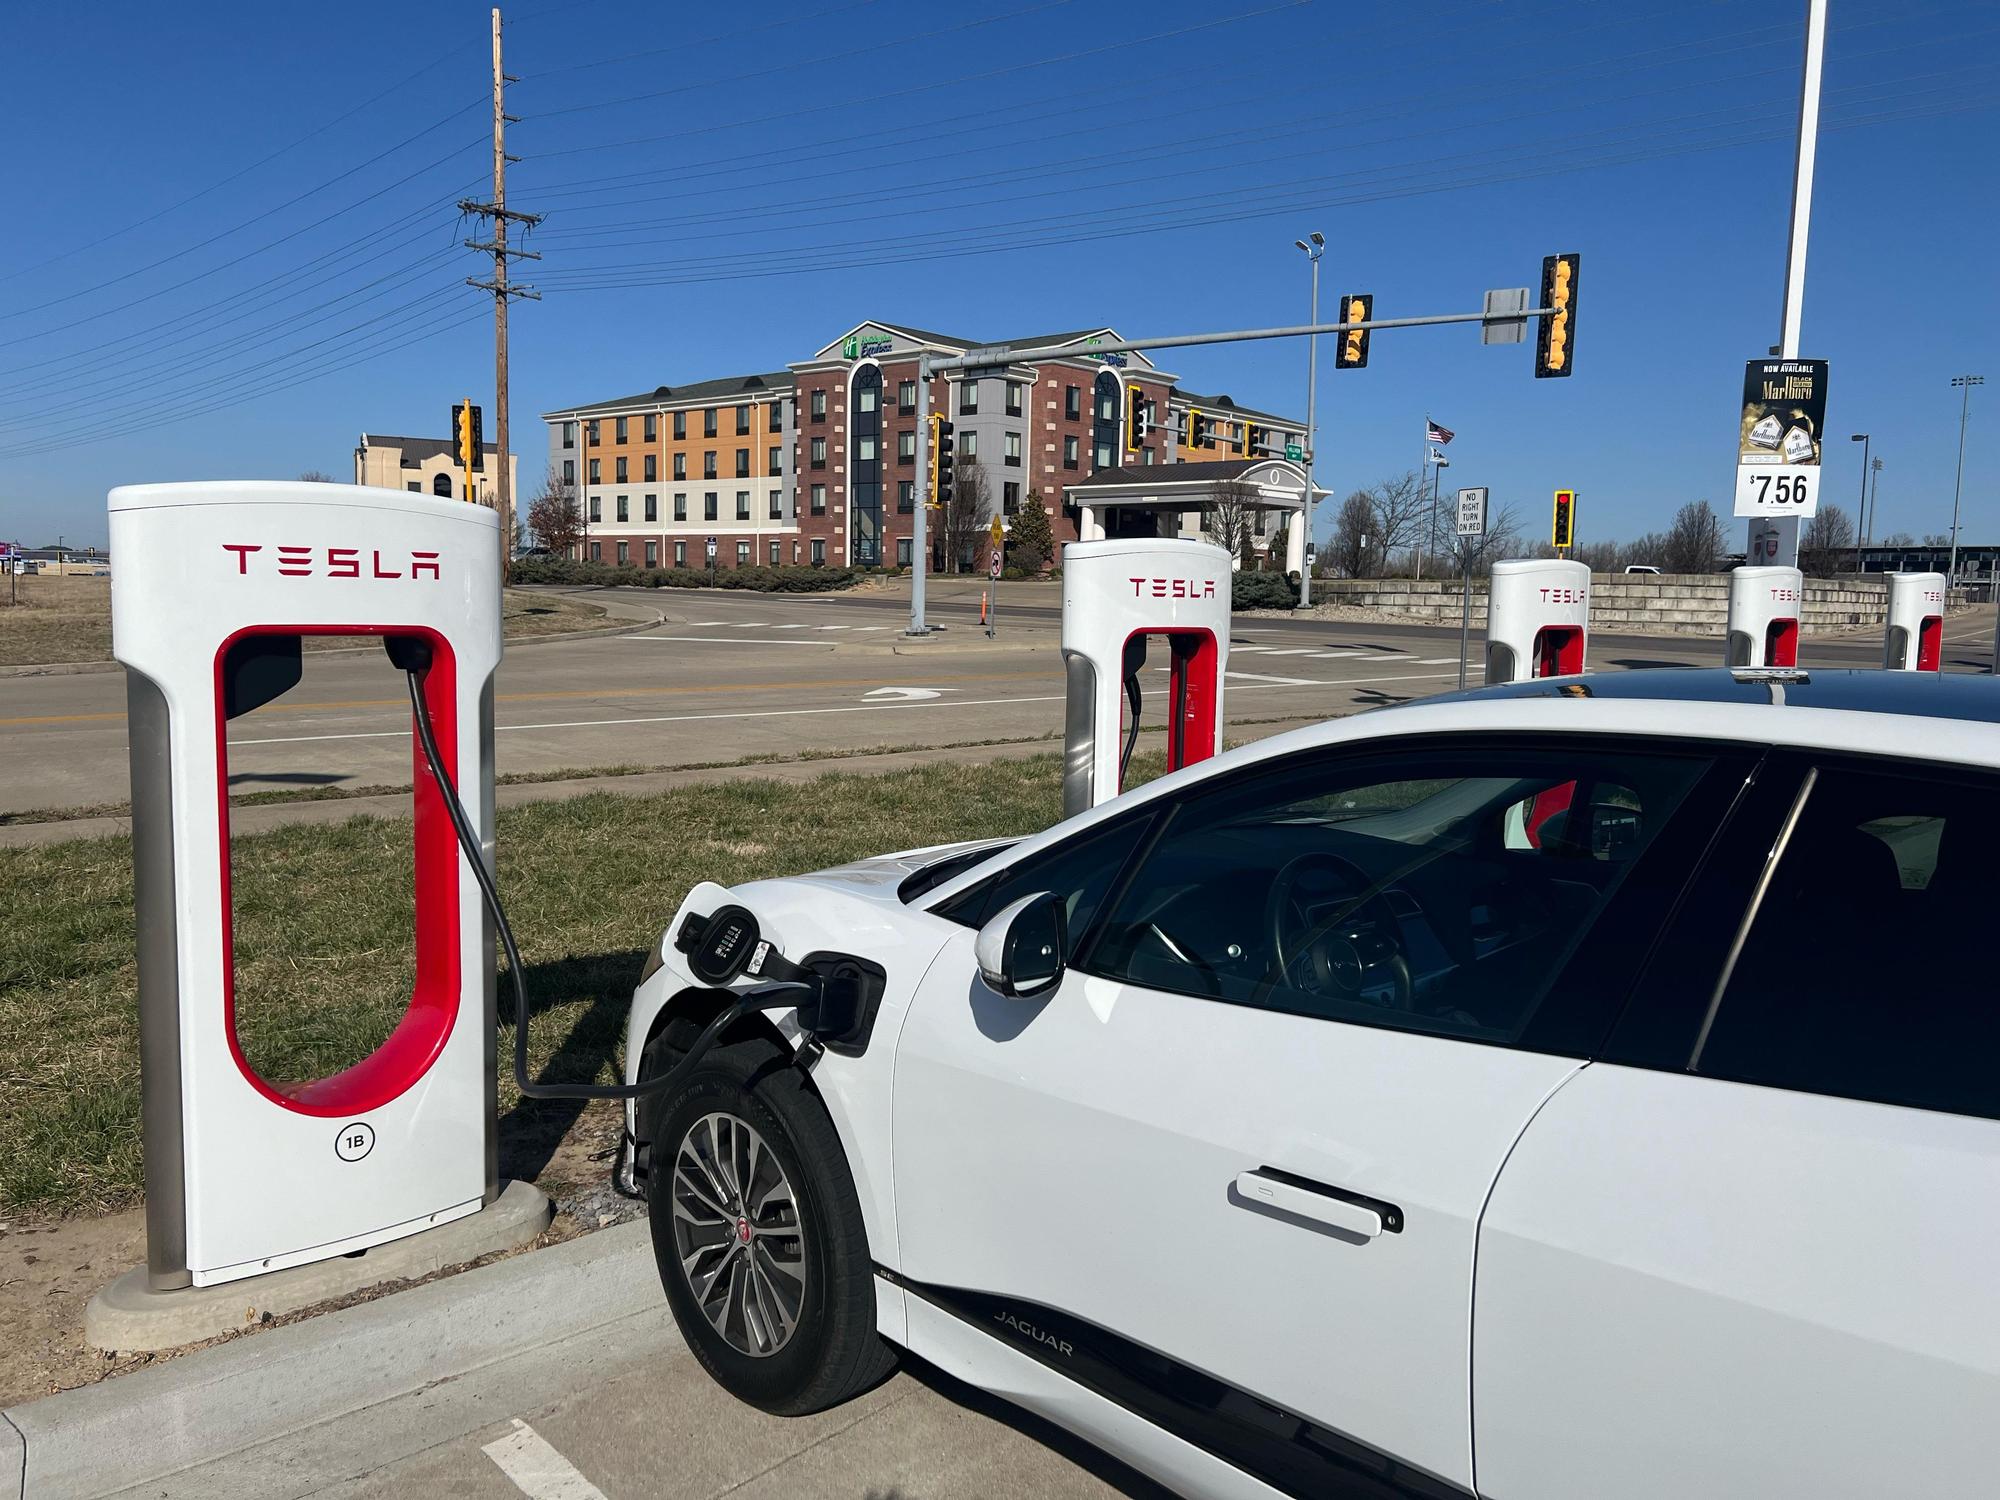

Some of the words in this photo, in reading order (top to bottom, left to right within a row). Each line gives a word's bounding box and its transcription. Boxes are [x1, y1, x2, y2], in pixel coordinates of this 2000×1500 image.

[1763, 365, 1779, 373] NOW
[1780, 365, 1814, 373] AVAILABLE
[1762, 376, 1812, 400] Marlboro
[1466, 493, 1476, 501] NO
[1462, 503, 1479, 511] RIGHT
[1463, 513, 1478, 521] TURN
[1469, 523, 1480, 531] RED
[222, 544, 440, 580] TESLA
[1129, 578, 1215, 599] TESLA
[1540, 589, 1585, 603] TESLA
[346, 1135, 364, 1148] 1B
[994, 1311, 1073, 1357] JAGUAR
